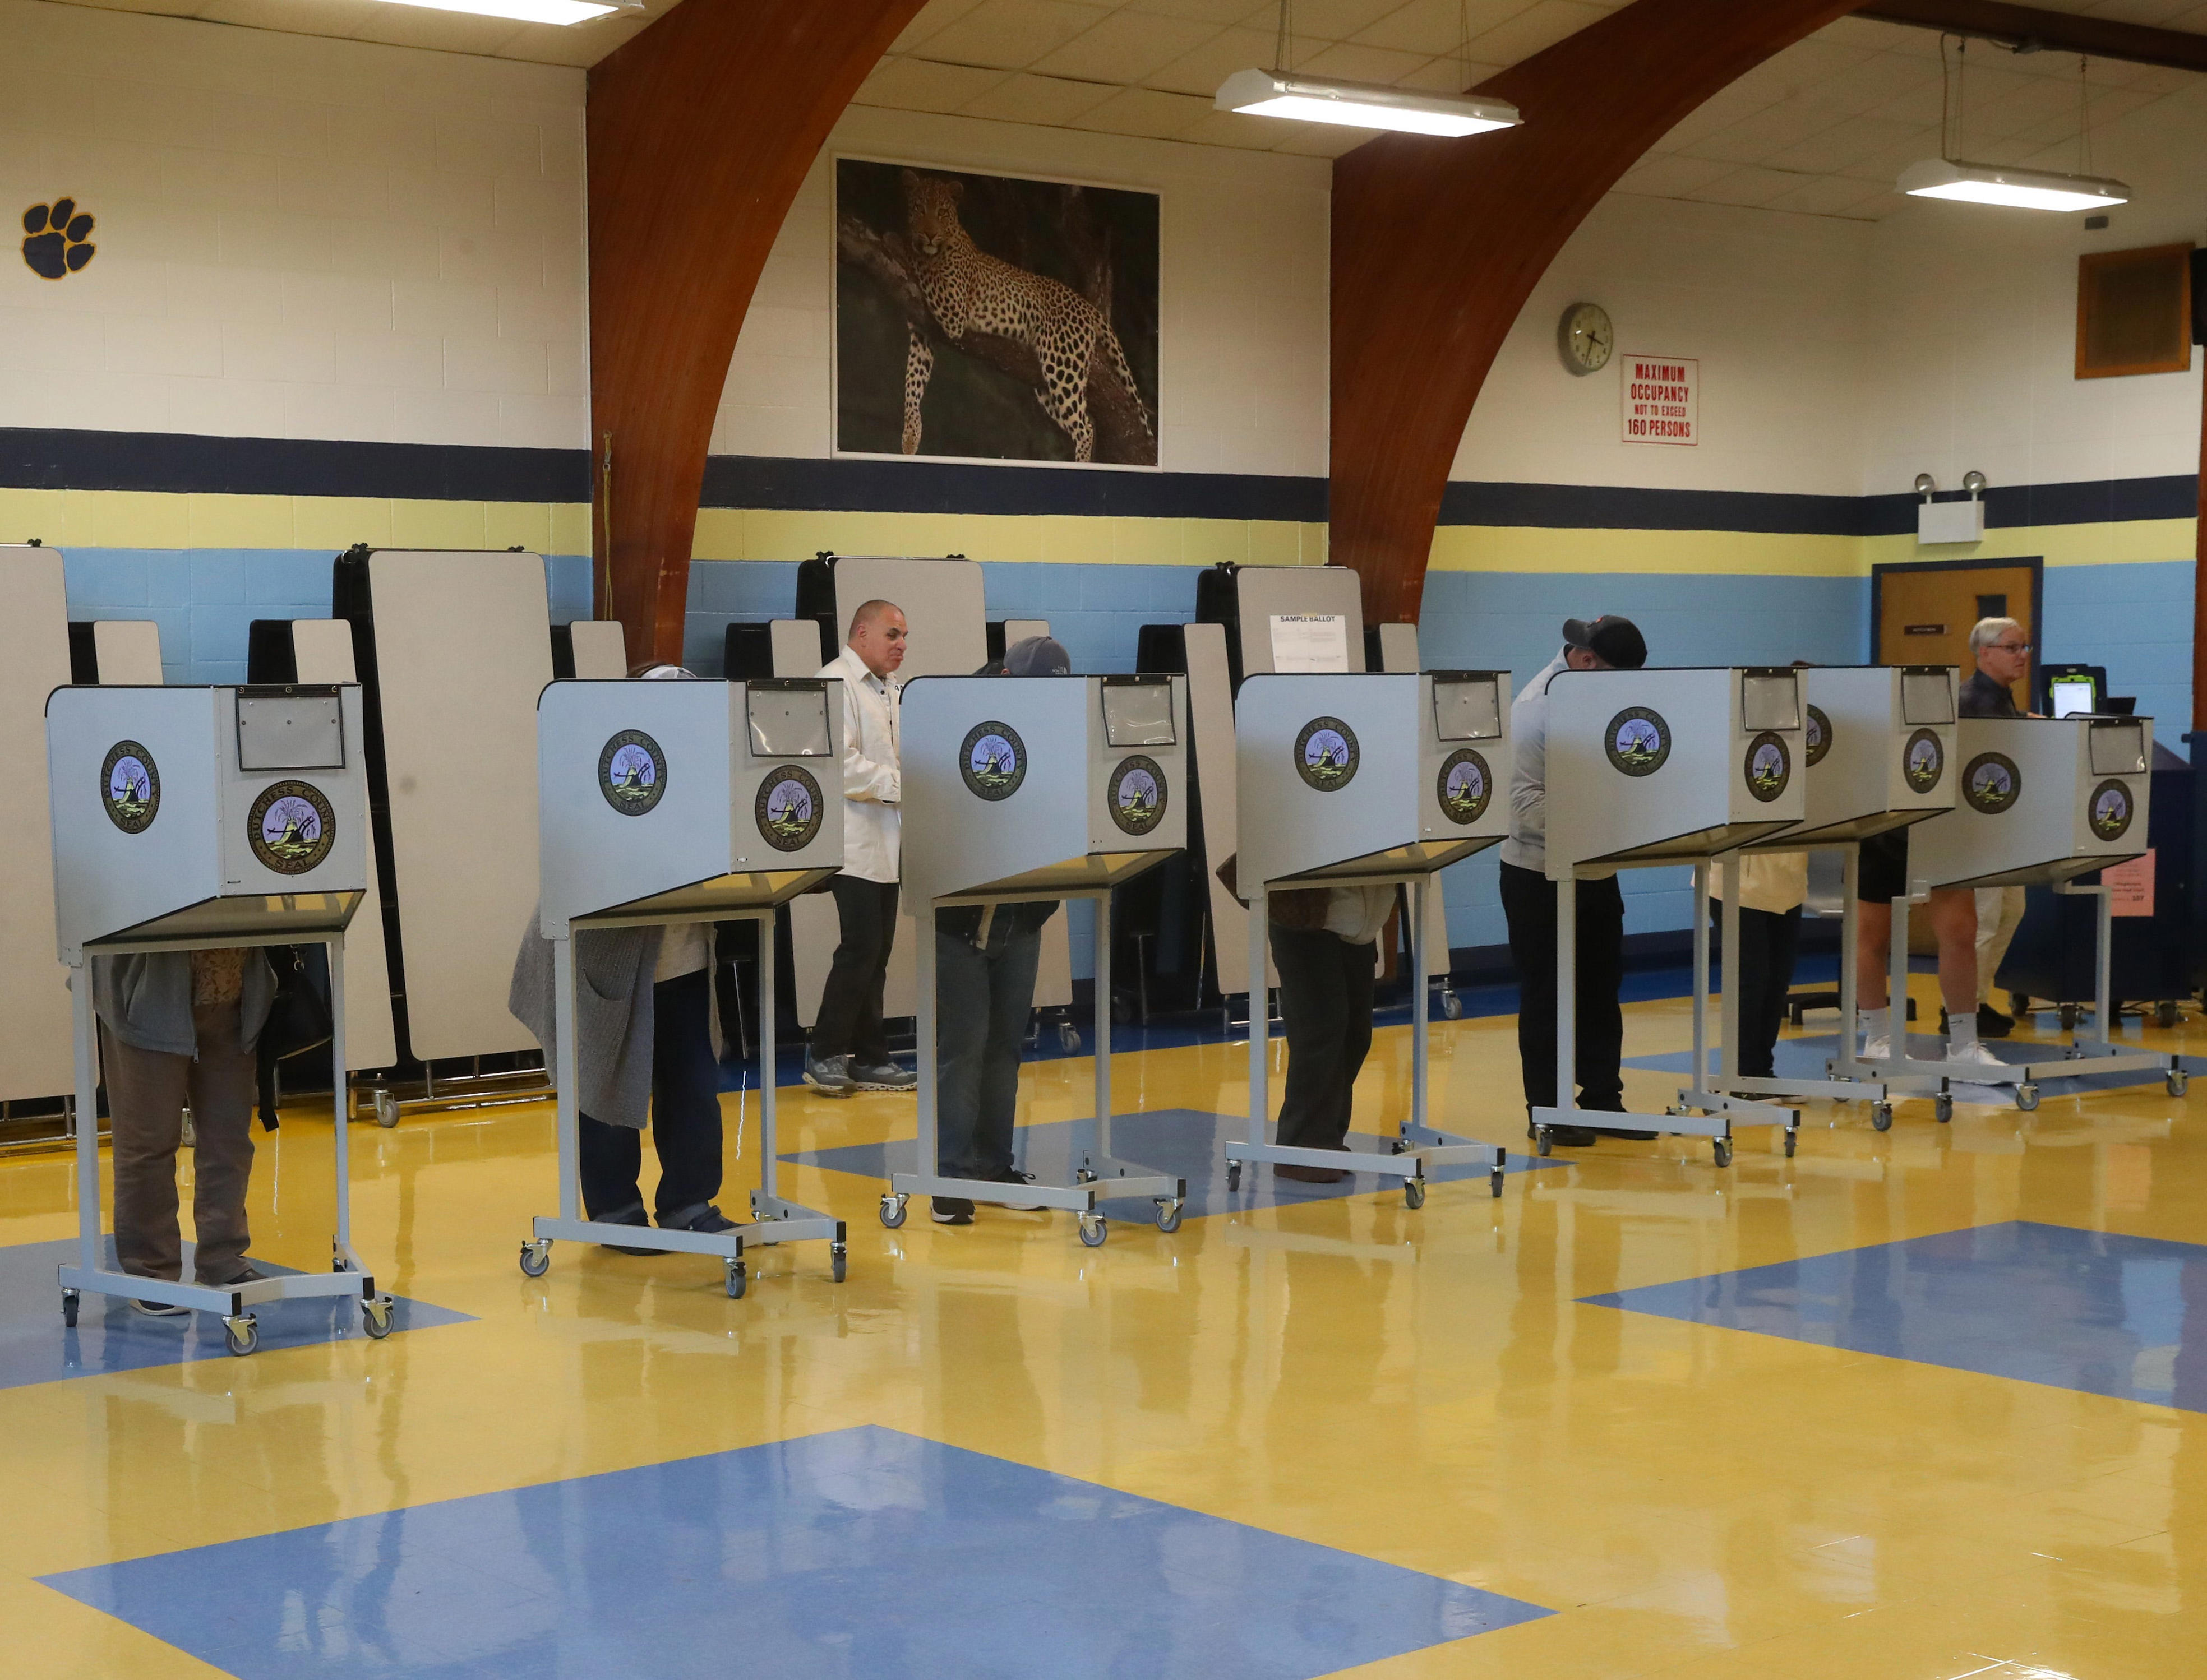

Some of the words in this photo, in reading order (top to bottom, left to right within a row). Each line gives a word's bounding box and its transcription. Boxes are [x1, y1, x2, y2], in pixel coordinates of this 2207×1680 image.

[1635, 364, 1686, 382] MAXIMUM
[1631, 383, 1689, 402] OCCUPANCY
[1635, 404, 1647, 415] NOT
[1651, 405, 1659, 416] TO
[1661, 406, 1686, 417] EXCEED
[1628, 419, 1646, 435] 160
[1650, 420, 1691, 437] PERSONS
[603, 735, 634, 783] DUTCHESS
[641, 738, 663, 783] COUNTY
[104, 747, 131, 798] DUTCHESS
[760, 771, 793, 818] DUTCHESS
[253, 786, 293, 840] DUTCHESS
[302, 789, 330, 836] COUNTY
[121, 818, 144, 827] SEAL
[275, 859, 311, 868] SEAL
